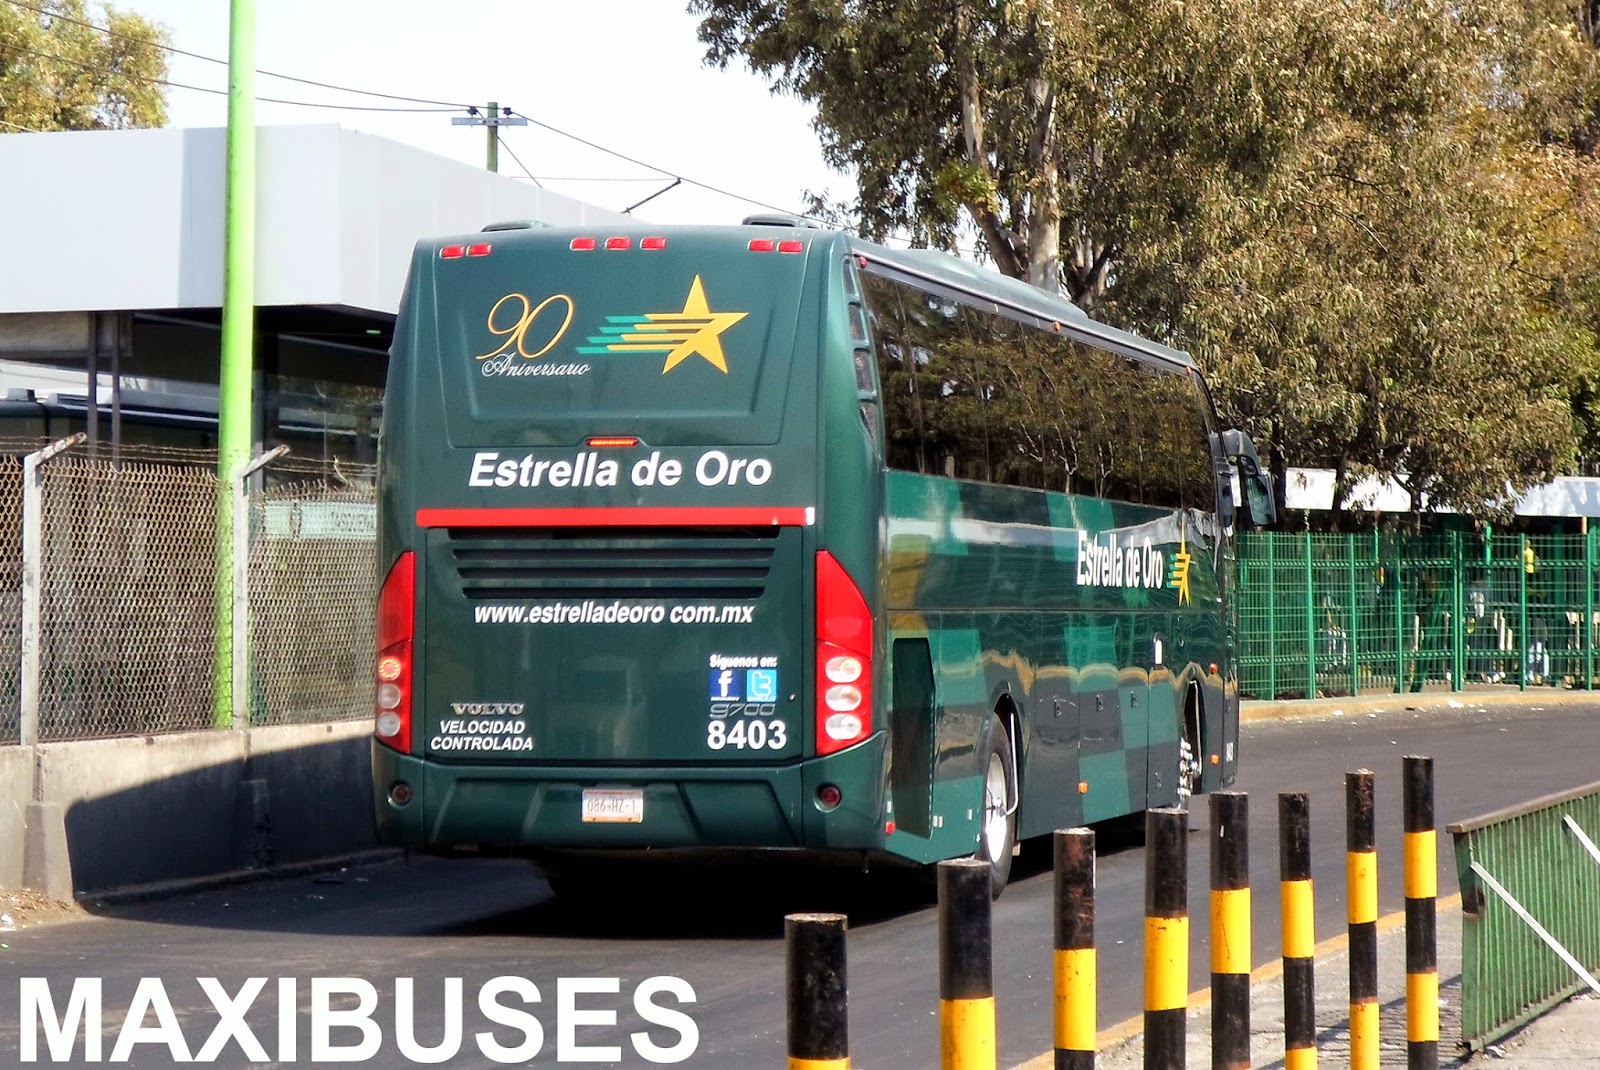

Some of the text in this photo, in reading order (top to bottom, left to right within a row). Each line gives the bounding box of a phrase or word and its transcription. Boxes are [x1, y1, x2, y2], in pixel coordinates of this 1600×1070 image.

[475, 292, 574, 359] 90
[481, 352, 591, 377] Aniversario
[468, 450, 772, 487] Estrella de Oro
[1076, 529, 1163, 589] Estrella de Oro
[709, 654, 758, 670] Síguenos
[450, 703, 525, 715] VOLVO
[440, 720, 526, 734] VELOCIDAD
[707, 720, 787, 750] 8403
[430, 737, 534, 751] CONTROLADA
